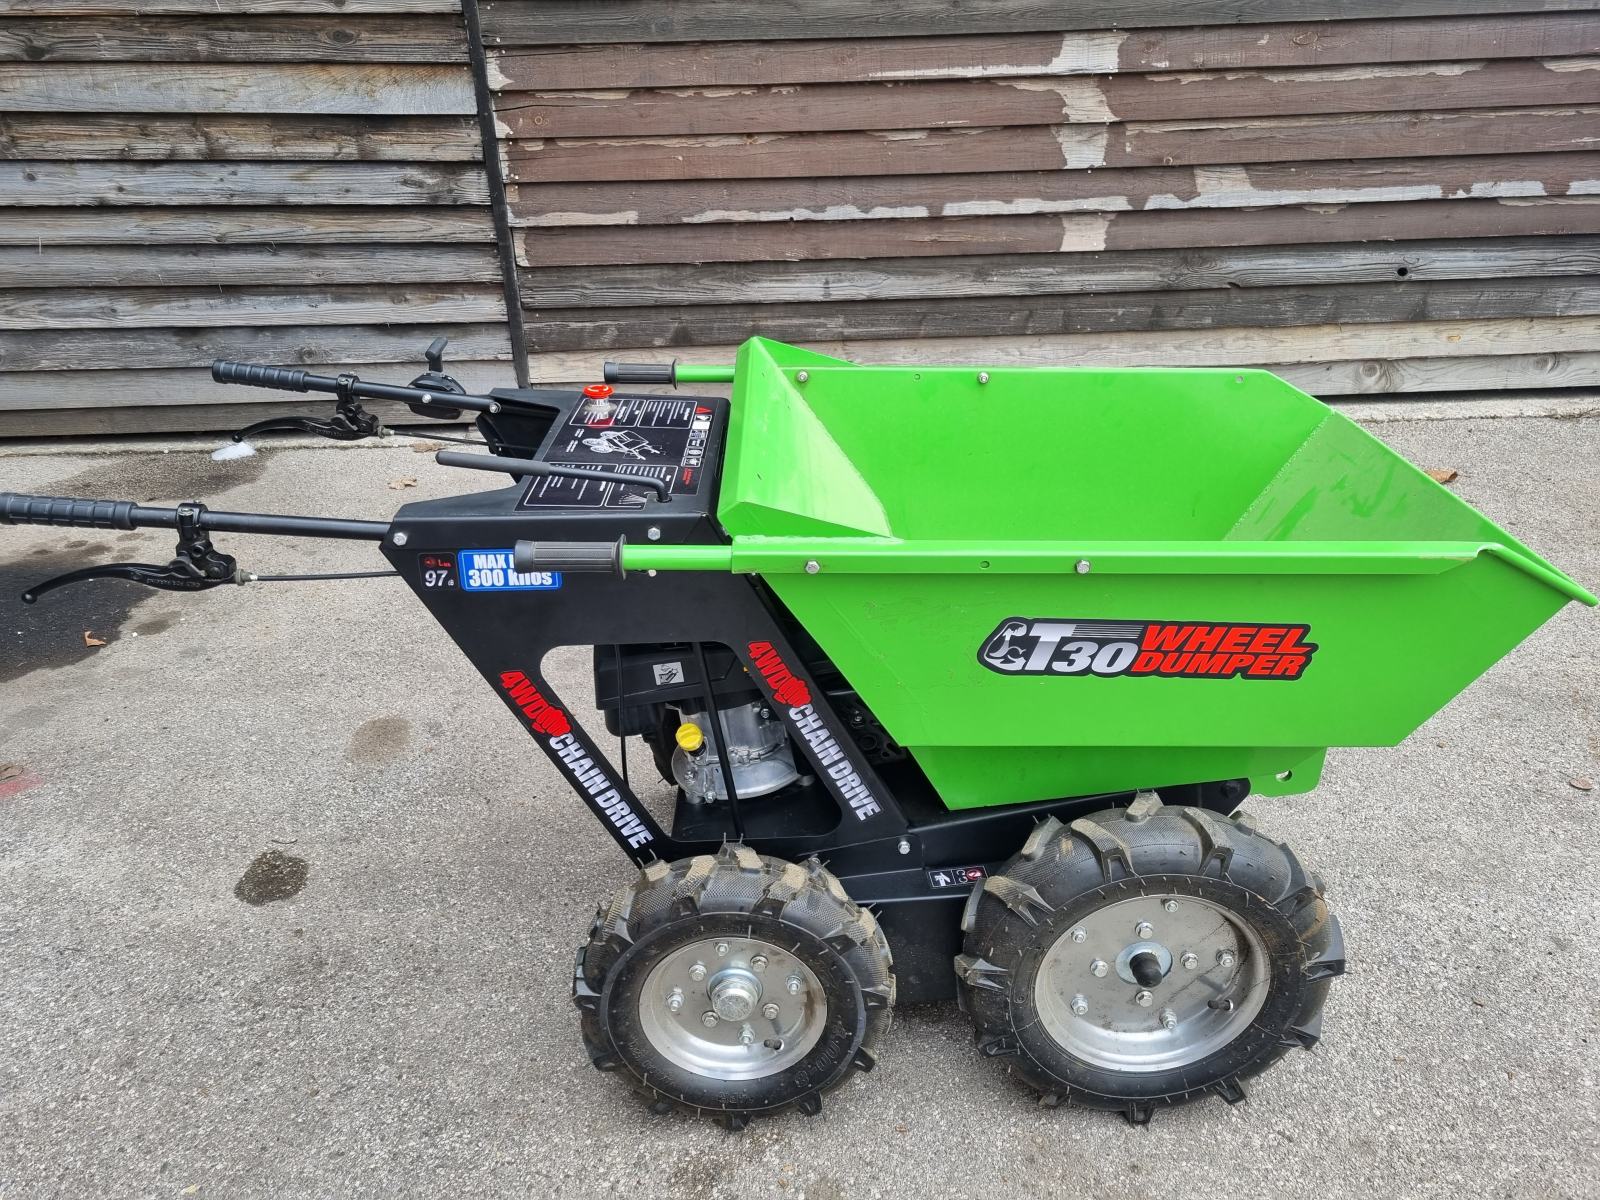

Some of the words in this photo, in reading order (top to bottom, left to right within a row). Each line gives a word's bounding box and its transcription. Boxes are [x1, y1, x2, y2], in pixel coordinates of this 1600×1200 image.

[474, 554, 507, 569] MAX
[425, 570, 448, 586] 97
[468, 569, 504, 586] 300
[1141, 625, 1315, 653] WHEEL
[1132, 652, 1306, 676] DUMPER
[748, 641, 792, 690] 4WD
[789, 703, 844, 766] CHAIN
[828, 760, 881, 821] DRIVE
[500, 671, 549, 719] 4WD
[550, 734, 611, 795] CHAIN
[595, 789, 655, 849] DRIVE
